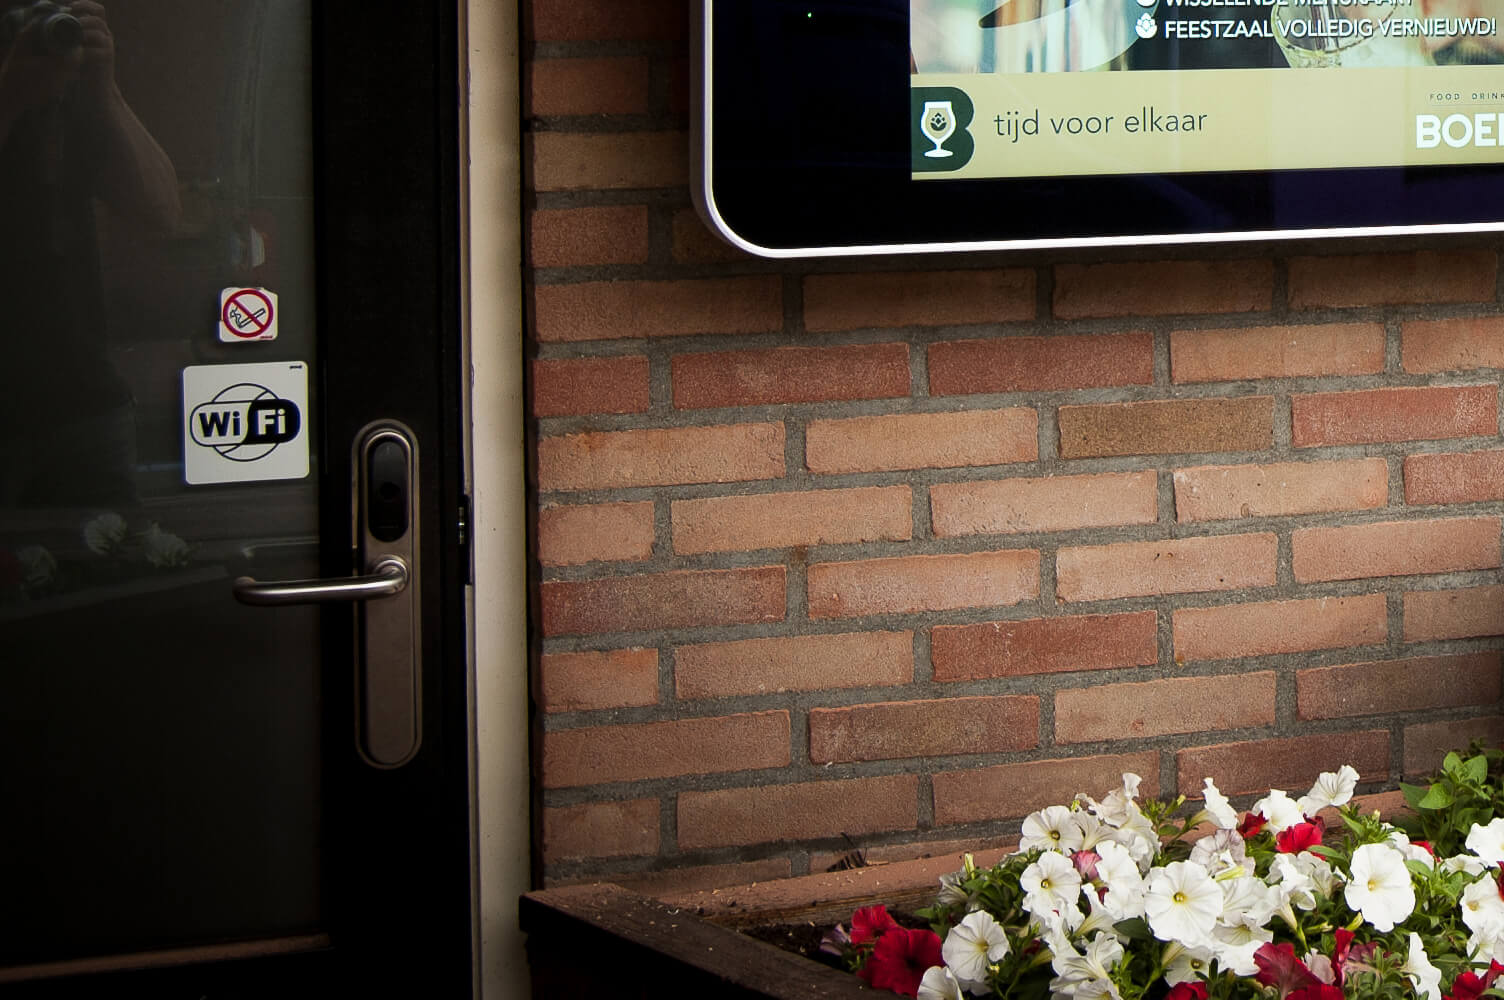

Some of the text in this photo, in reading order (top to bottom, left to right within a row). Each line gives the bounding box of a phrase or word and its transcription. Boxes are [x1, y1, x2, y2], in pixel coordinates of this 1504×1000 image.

[1165, 18, 1497, 39] FEESTZAAL VOLLEDIG VERNIEUWD!
[1430, 92, 1461, 101] FOOD
[993, 106, 1208, 143] tijd voor elkaar
